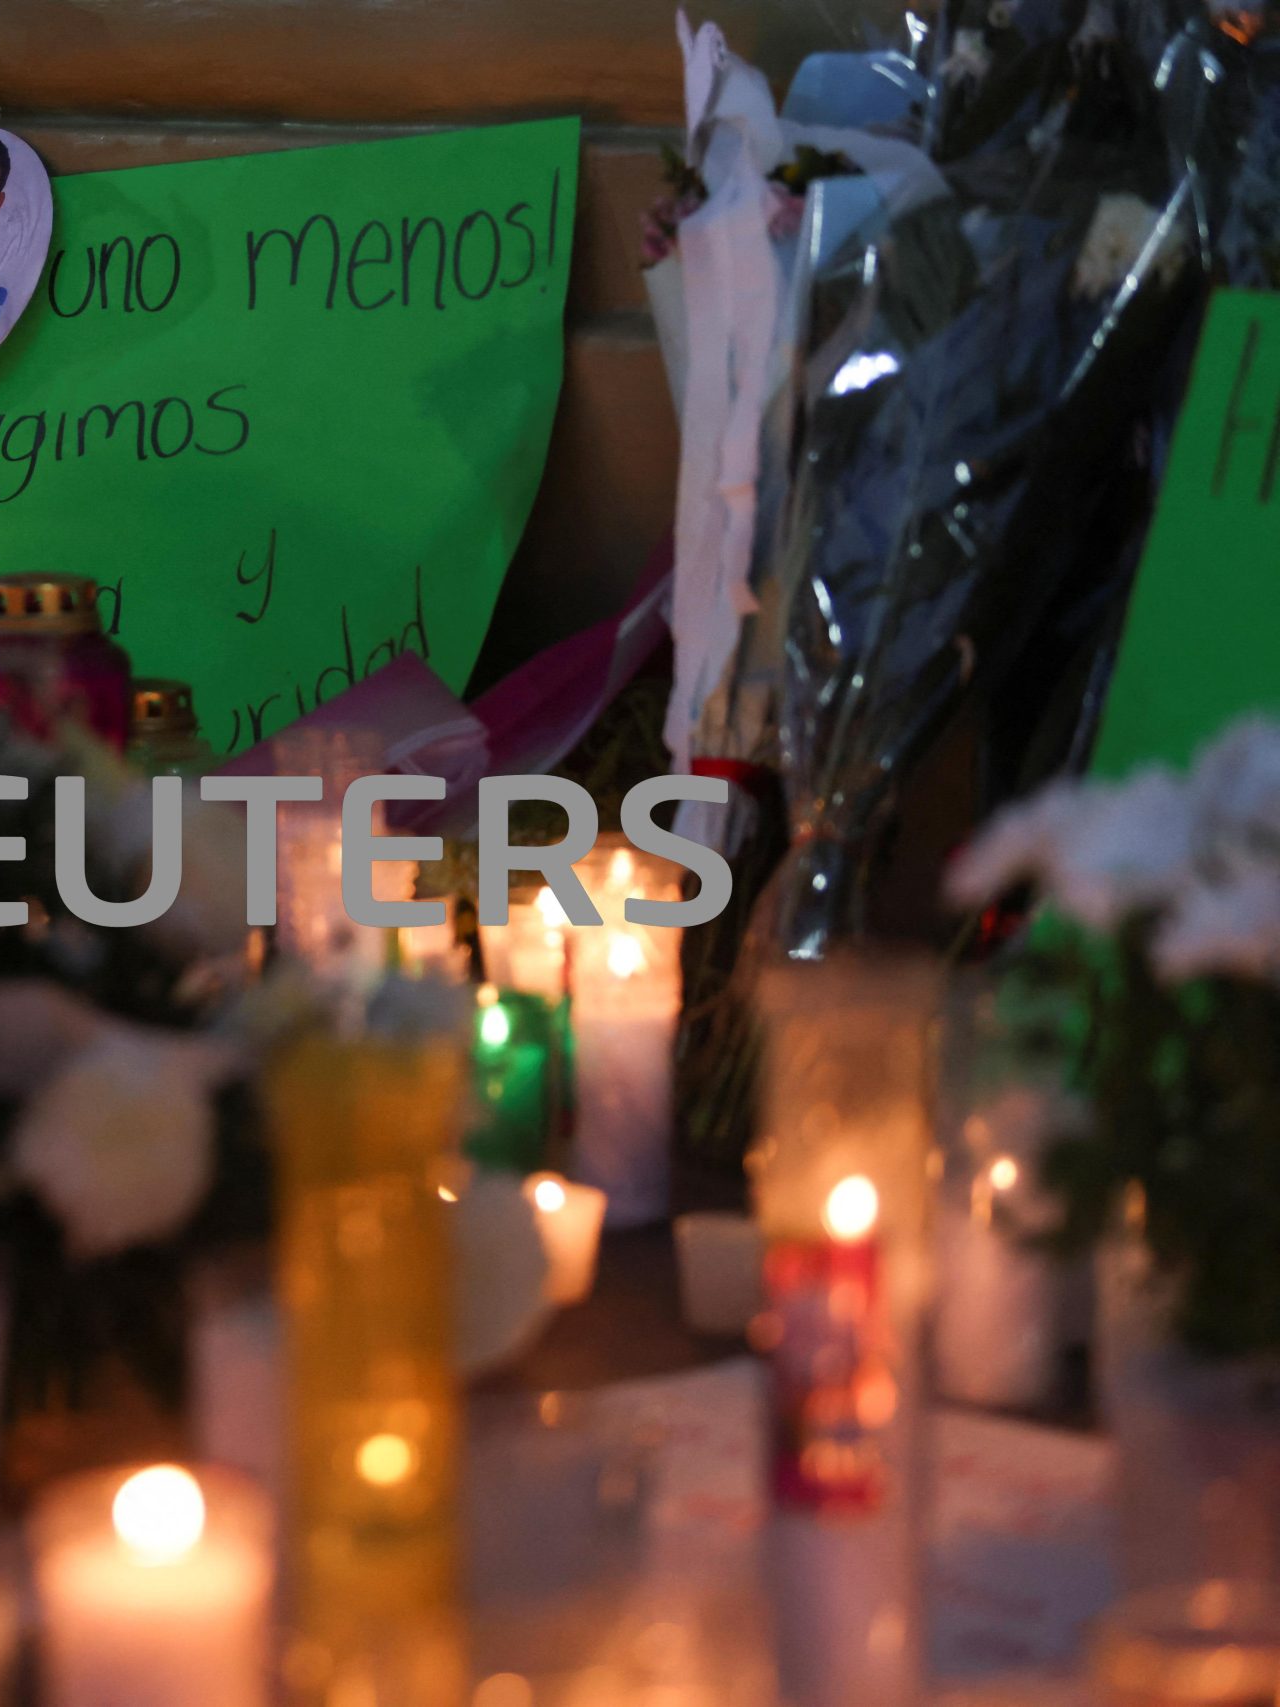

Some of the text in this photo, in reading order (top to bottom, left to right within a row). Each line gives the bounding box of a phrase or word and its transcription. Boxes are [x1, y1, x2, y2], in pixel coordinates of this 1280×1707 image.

[48, 166, 560, 318] uno menos!
[236, 528, 275, 624] y
